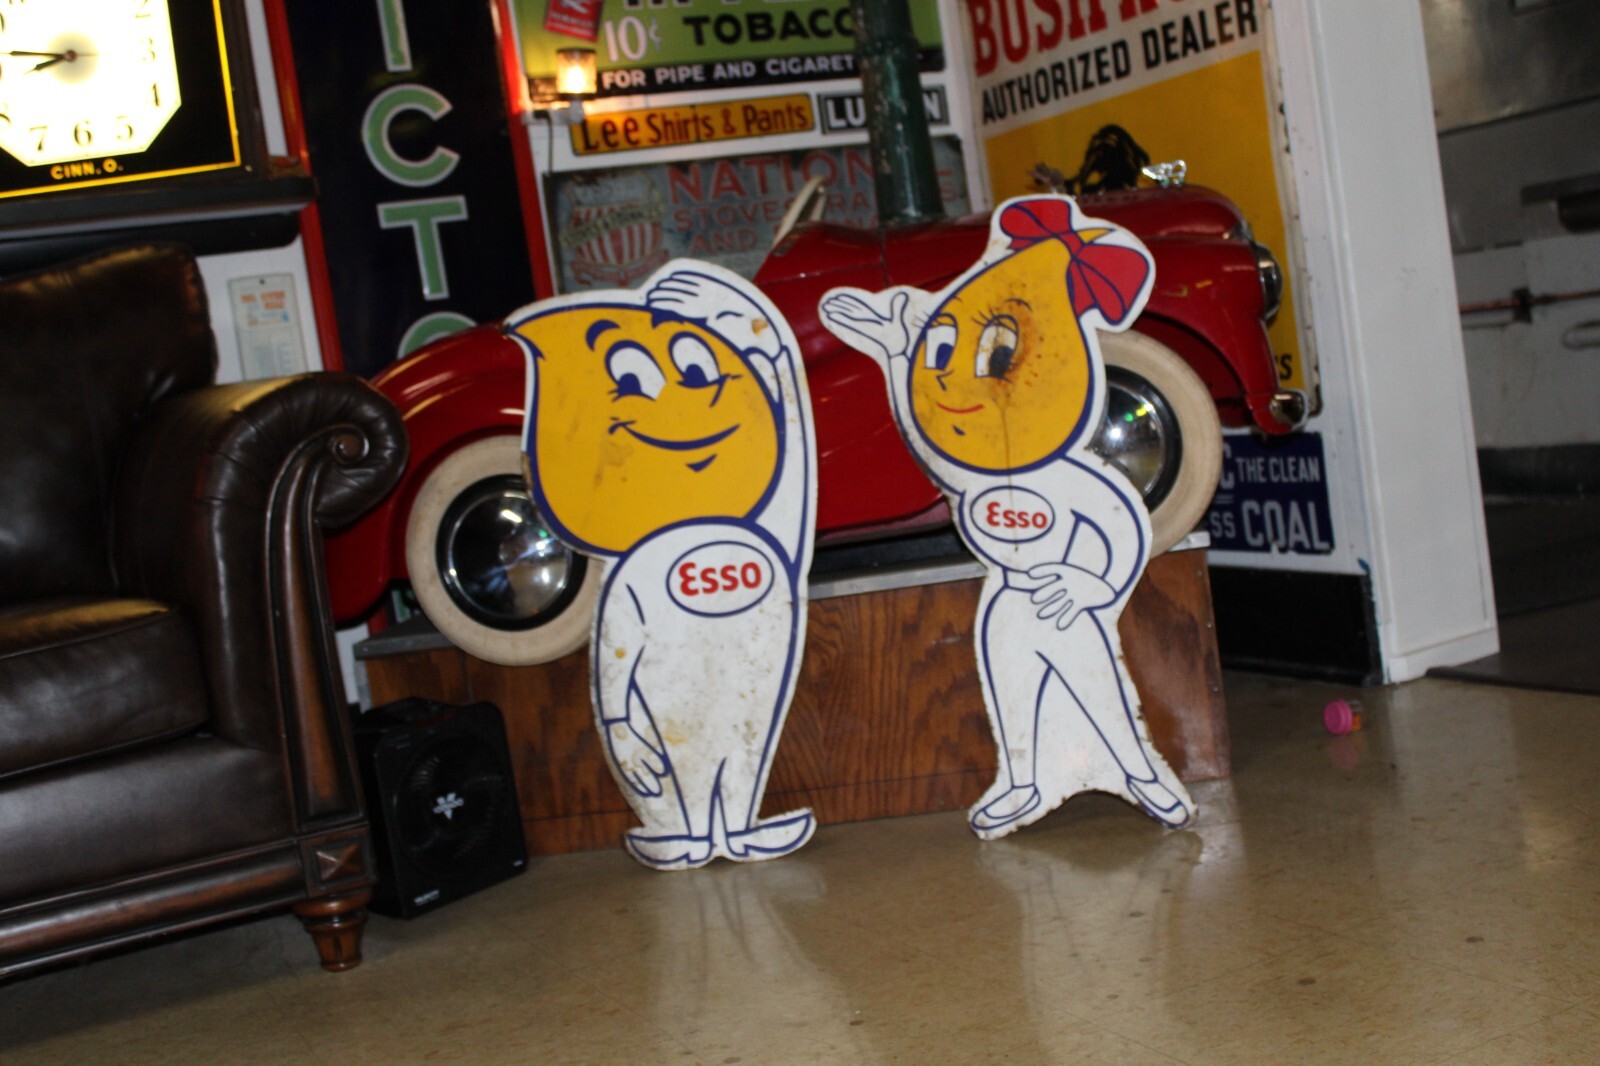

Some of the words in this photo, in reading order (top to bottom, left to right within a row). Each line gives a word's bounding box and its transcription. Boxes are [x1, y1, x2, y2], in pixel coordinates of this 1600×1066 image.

[682, 8, 856, 46] TOBACC
[602, 69, 646, 90] FOR
[654, 64, 706, 85] PIPE
[713, 61, 756, 80] AND
[765, 55, 854, 76] CIGARET
[982, 39, 1132, 125] AUTHORIZED
[1141, 0, 1258, 70] DEALER
[29, 126, 48, 152] 7
[73, 120, 92, 147] 6
[115, 116, 133, 141] 5
[581, 115, 641, 151] Lee
[646, 106, 714, 144] Shirts
[722, 107, 736, 136] &
[742, 102, 809, 135] Pants
[667, 147, 954, 204] NATION
[689, 229, 758, 256] AND
[1236, 457, 1267, 483] THE
[1270, 456, 1320, 483] CLEAN
